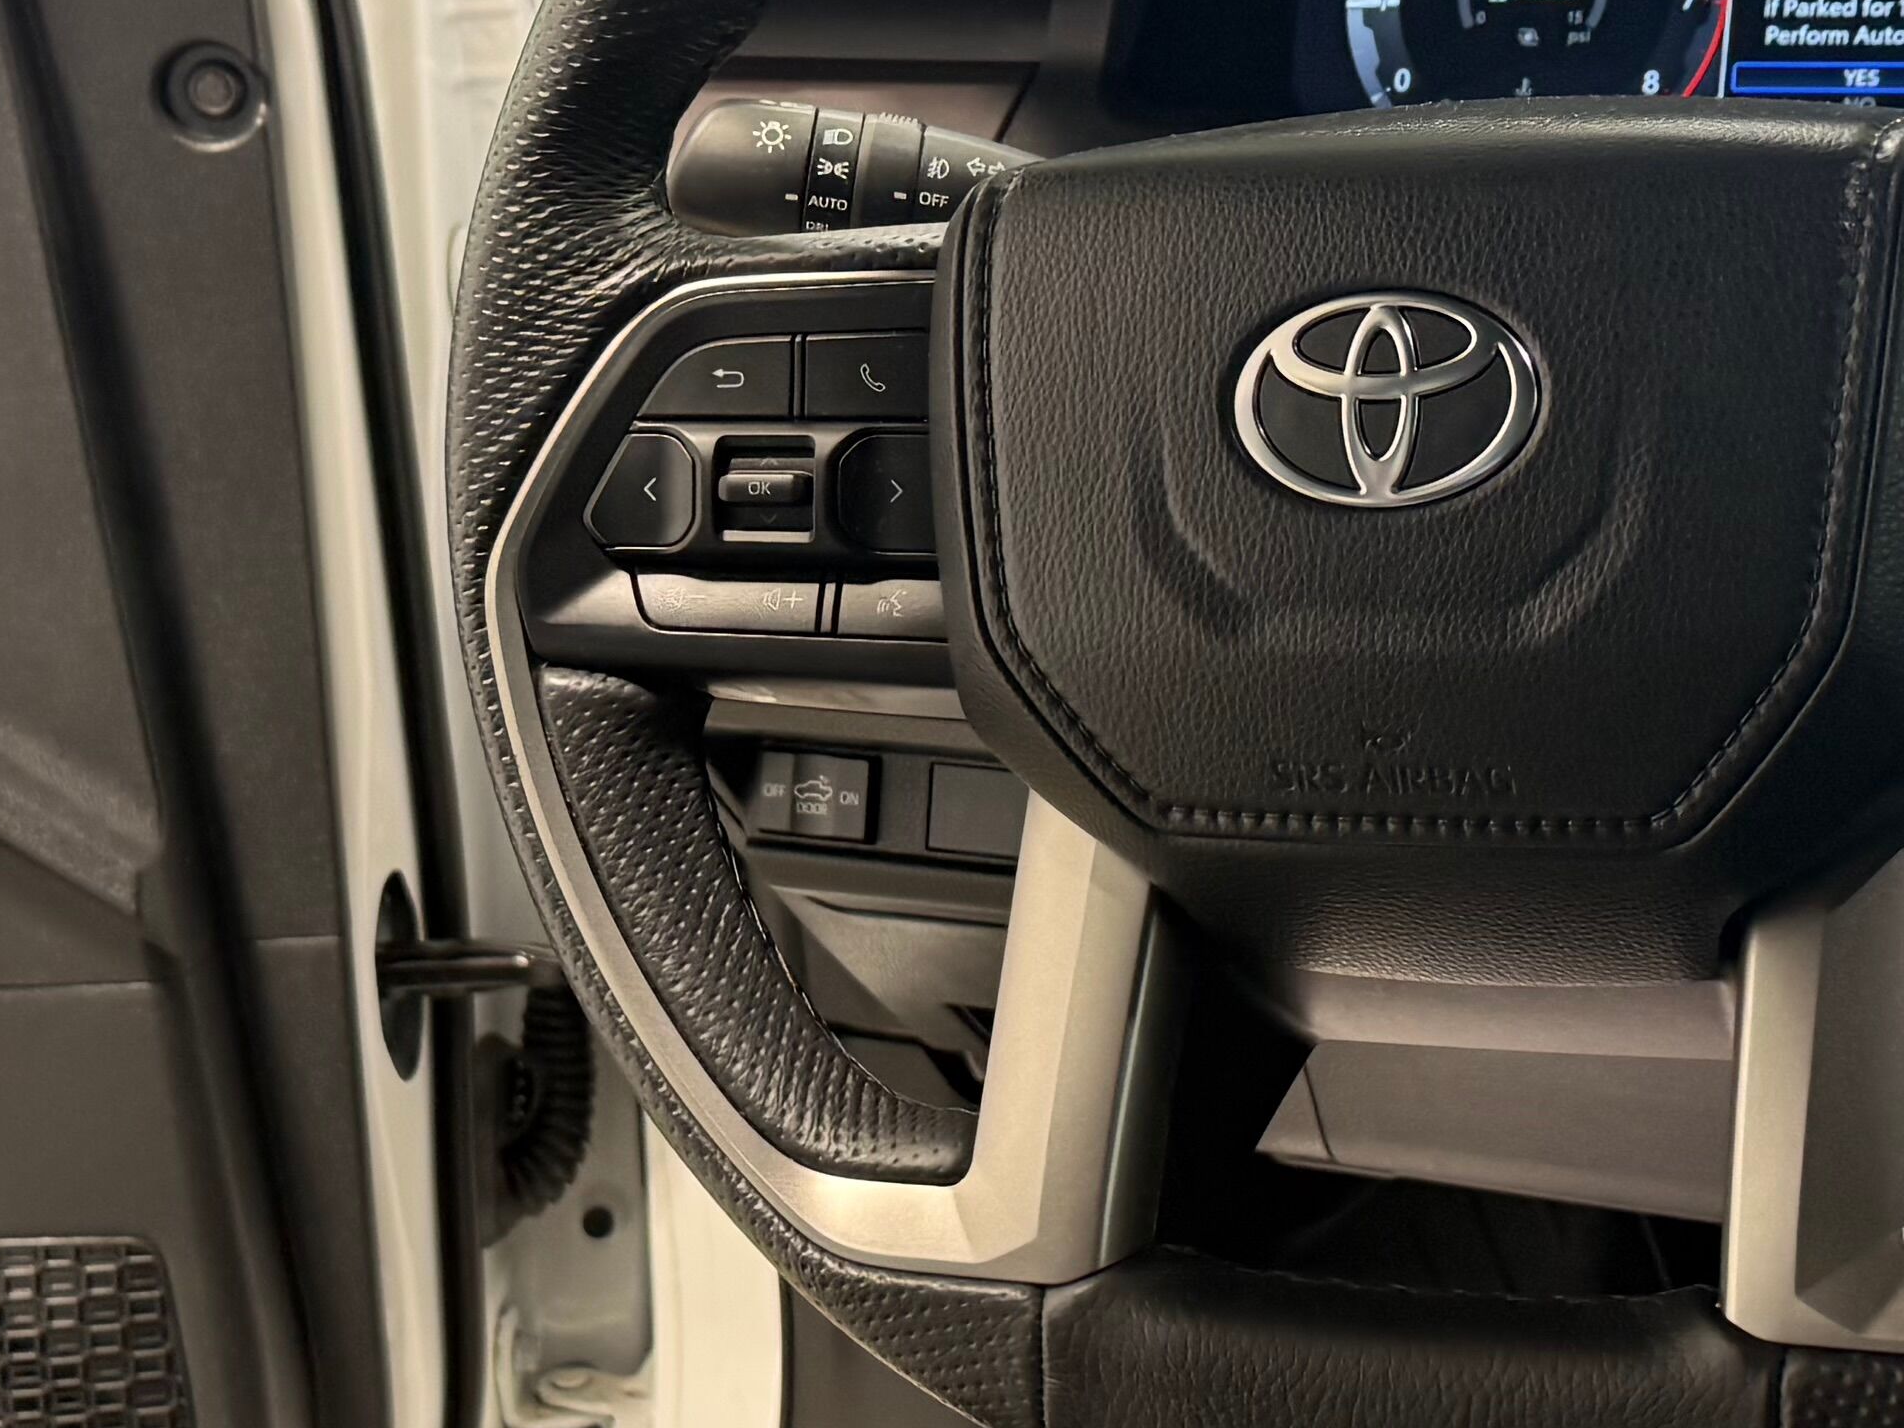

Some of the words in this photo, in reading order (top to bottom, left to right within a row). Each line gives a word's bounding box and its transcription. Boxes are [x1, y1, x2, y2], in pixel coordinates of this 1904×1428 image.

[1566, 28, 1592, 47] psi
[1765, 24, 1850, 46] Perform
[1394, 68, 1411, 94] 0
[1641, 69, 1661, 96] 8
[1844, 69, 1880, 87] YES
[808, 195, 848, 211] AUTO
[919, 191, 949, 208] OFF
[748, 481, 771, 496] OK
[762, 783, 787, 798] OFF
[840, 791, 859, 806] ON
